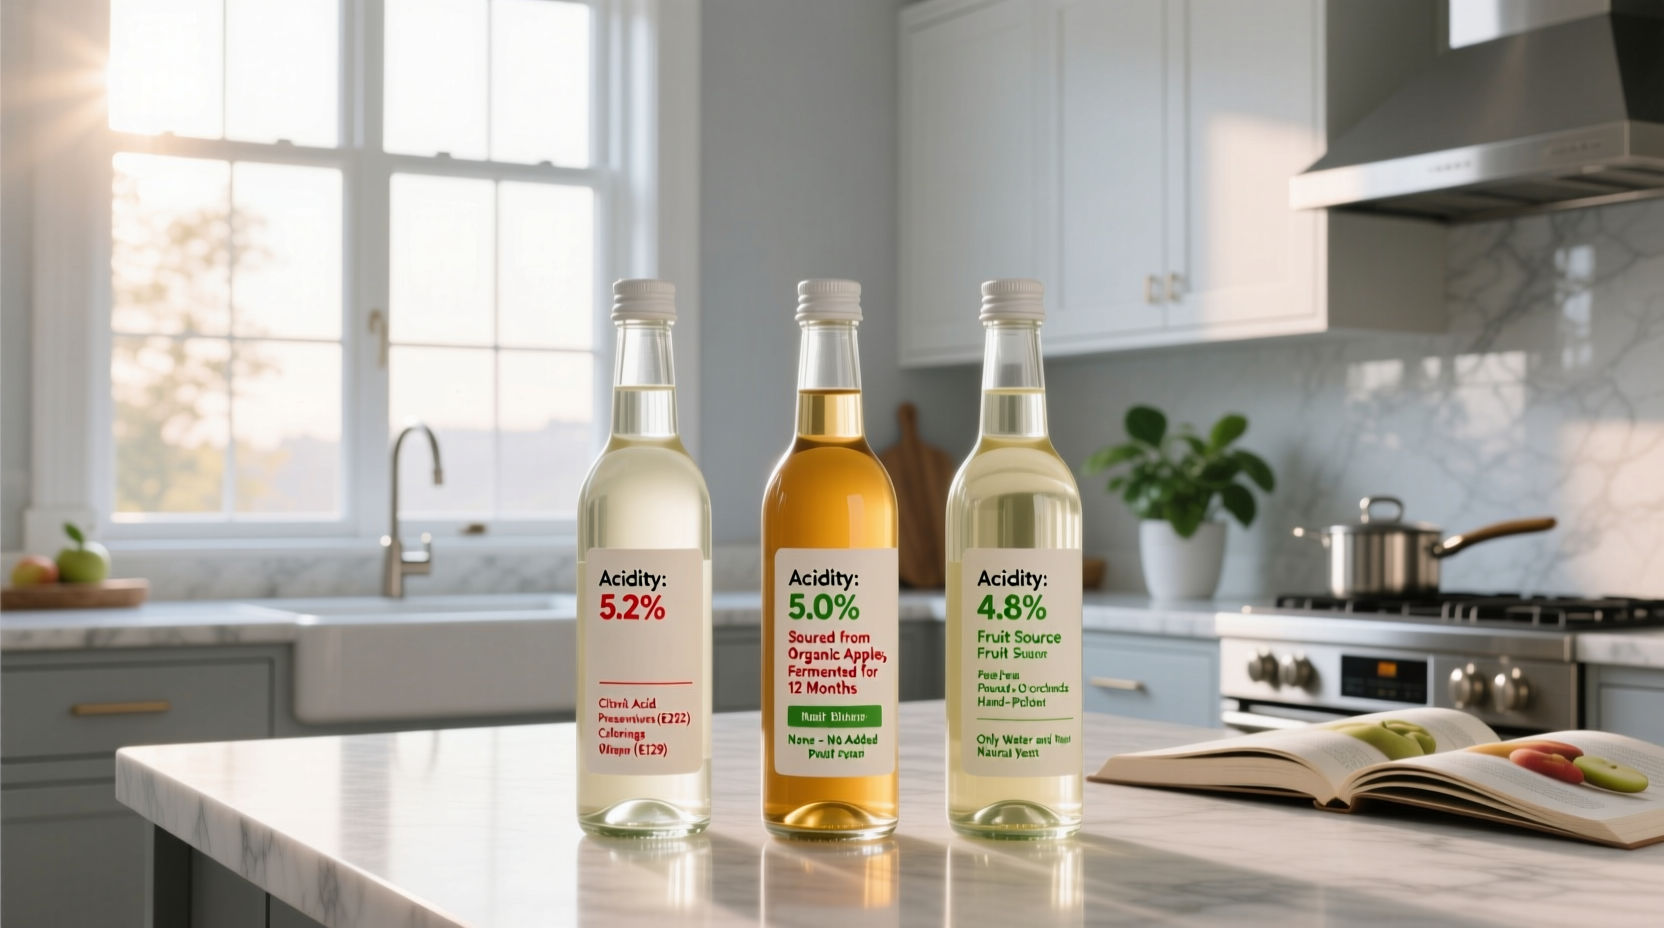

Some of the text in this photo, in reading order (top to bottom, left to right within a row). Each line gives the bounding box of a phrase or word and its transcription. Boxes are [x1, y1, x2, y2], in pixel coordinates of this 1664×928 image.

[599, 569, 666, 592] Acidity:
[788, 568, 859, 592] Acidity:
[977, 569, 1047, 592] Acidity:
[599, 593, 666, 620] 5.2%
[788, 593, 860, 620] 5.0%
[977, 593, 1047, 620] 4.8%
[840, 630, 870, 643] from
[978, 629, 1062, 644] Fruit Source
[788, 646, 841, 665] Organic
[977, 646, 1008, 659] Fruit
[788, 664, 878, 678] Fermented for
[788, 680, 858, 695] 12 Months
[631, 697, 657, 709] Acid
[827, 734, 842, 746] No
[844, 733, 878, 746] Added
[976, 733, 999, 748] Only
[633, 742, 668, 758] (E129)
